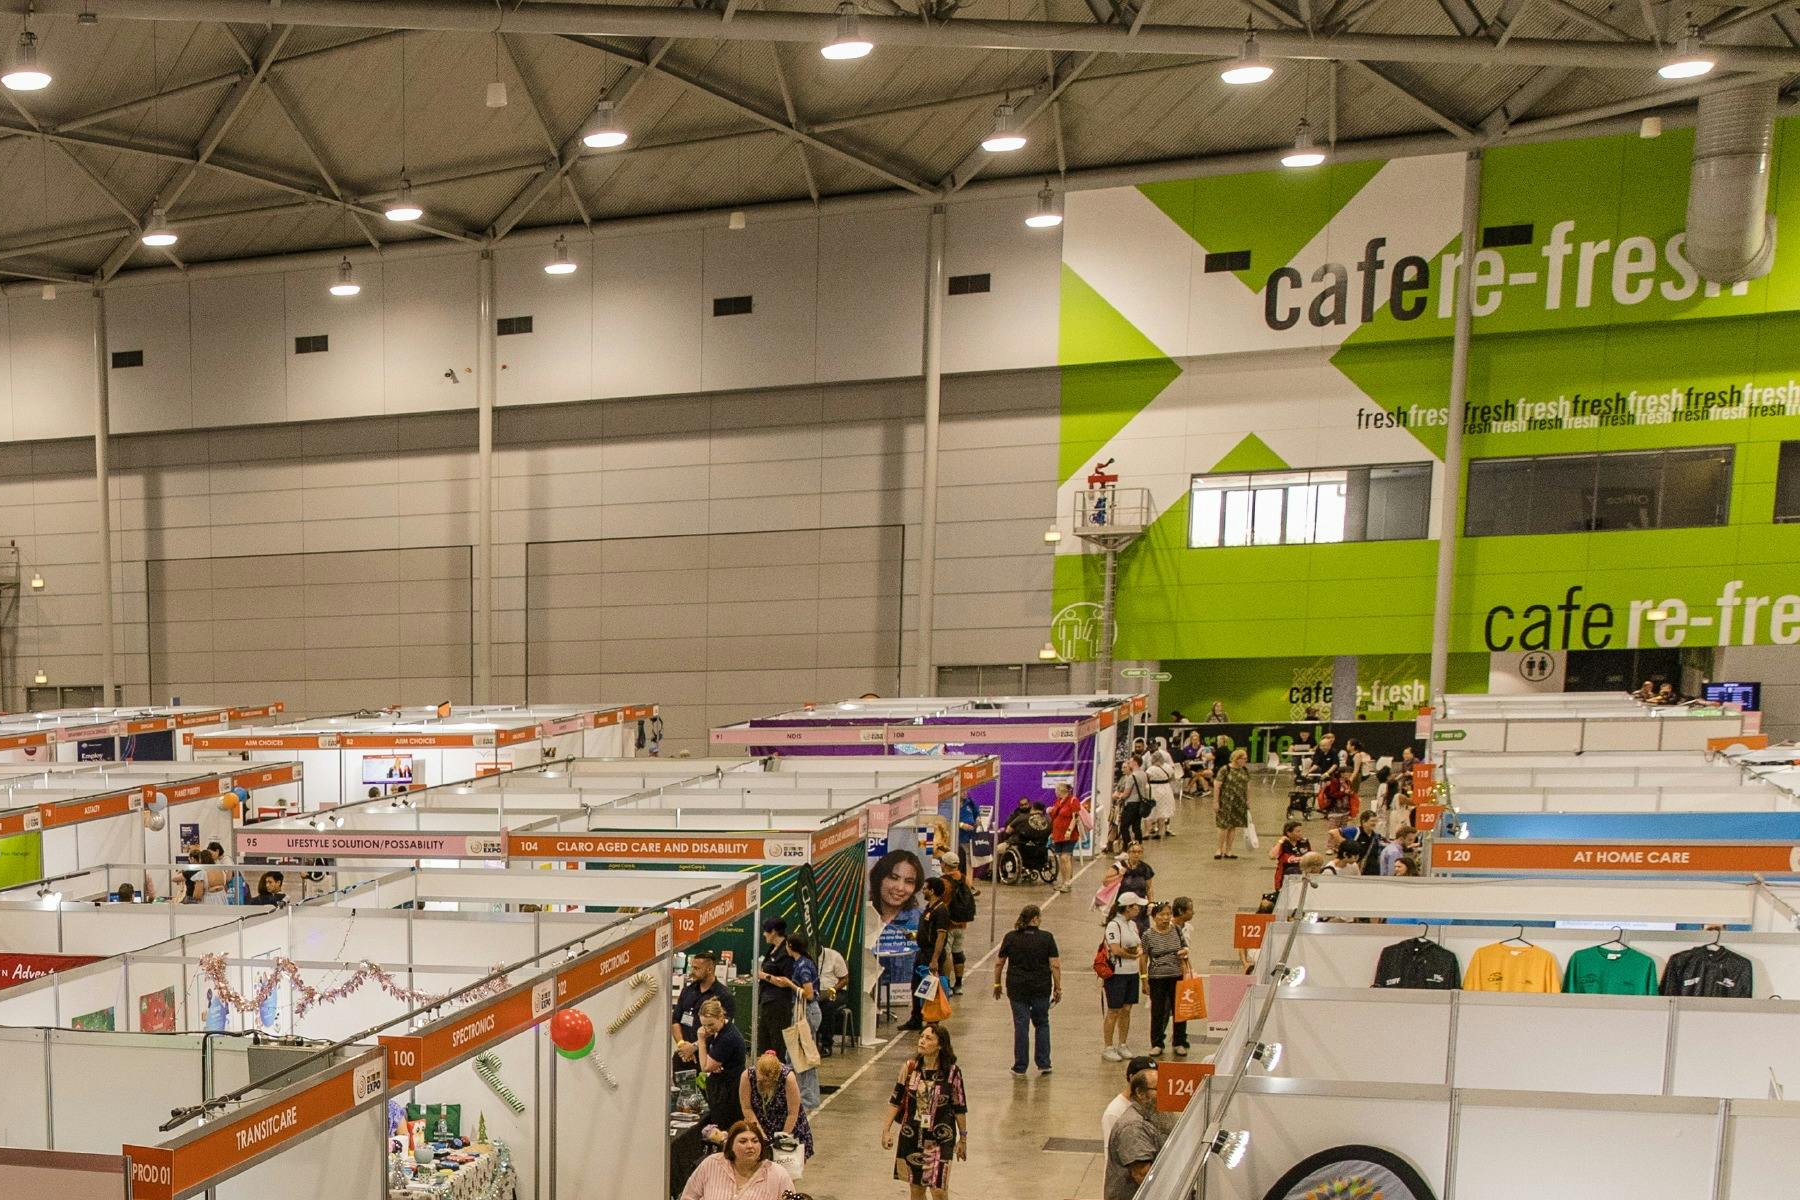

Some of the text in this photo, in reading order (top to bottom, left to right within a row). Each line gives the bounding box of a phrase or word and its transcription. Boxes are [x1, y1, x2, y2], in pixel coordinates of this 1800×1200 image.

[1265, 220, 1750, 331] cafe re-fres
[1484, 585, 1614, 652] cafe
[412, 737, 436, 745] CHOICES
[1420, 813, 1435, 823] 120
[246, 838, 258, 847] 95
[287, 838, 330, 850] LIFESTYLE
[521, 841, 749, 854] 104 CLARO AGED CARE AND DISABILITY
[1446, 850, 1690, 864] 120 AT HOME CARE
[678, 919, 695, 931] 102
[1240, 925, 1261, 937] 122
[452, 1014, 495, 1048] SPECTRONICS
[393, 1050, 415, 1066] 100
[367, 1080, 381, 1094] EXPO
[1167, 1079, 1194, 1095] 124
[236, 1106, 298, 1150] TRANSITCARE
[132, 1163, 171, 1185] PROD 01
